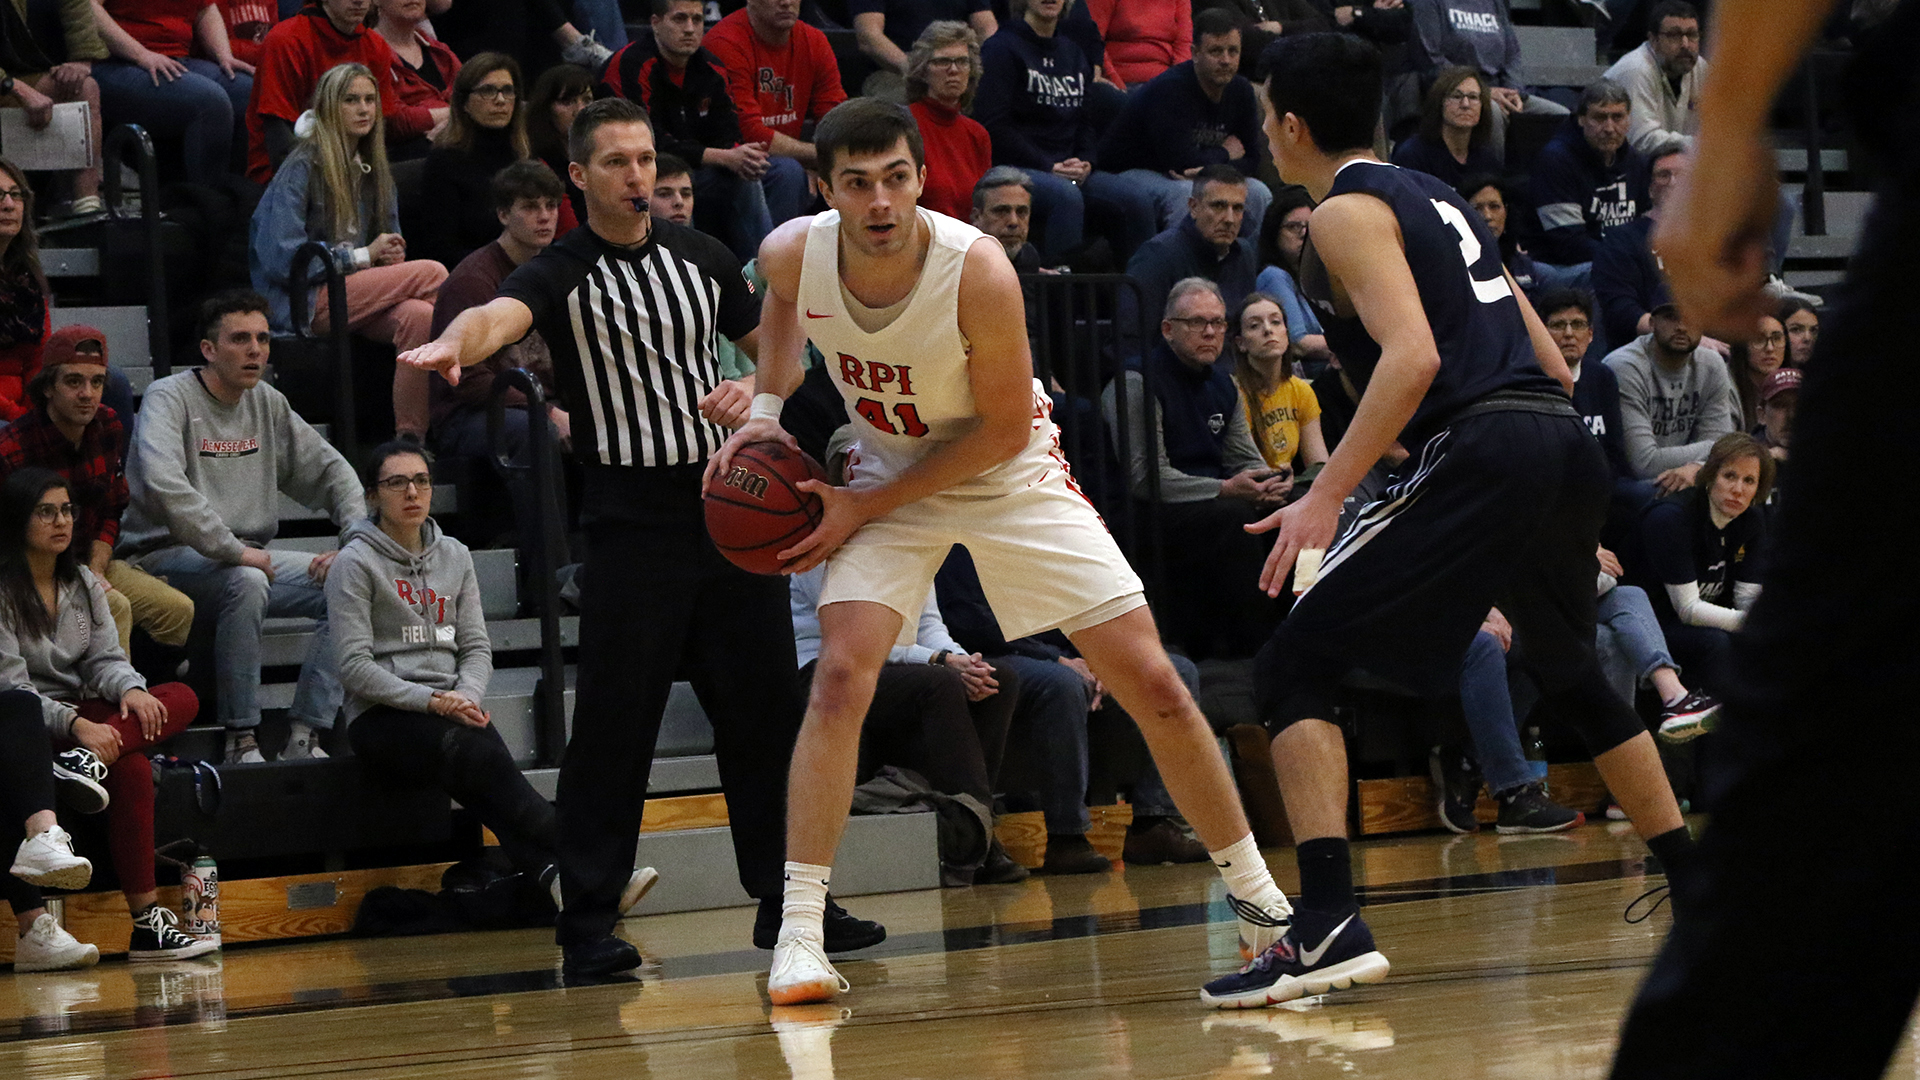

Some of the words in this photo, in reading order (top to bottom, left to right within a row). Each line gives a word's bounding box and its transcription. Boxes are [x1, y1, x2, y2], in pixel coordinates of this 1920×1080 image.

[1429, 198, 1514, 304] 2
[836, 351, 917, 396] RPI
[855, 396, 930, 438] 41
[401, 625, 432, 643] FIEL
